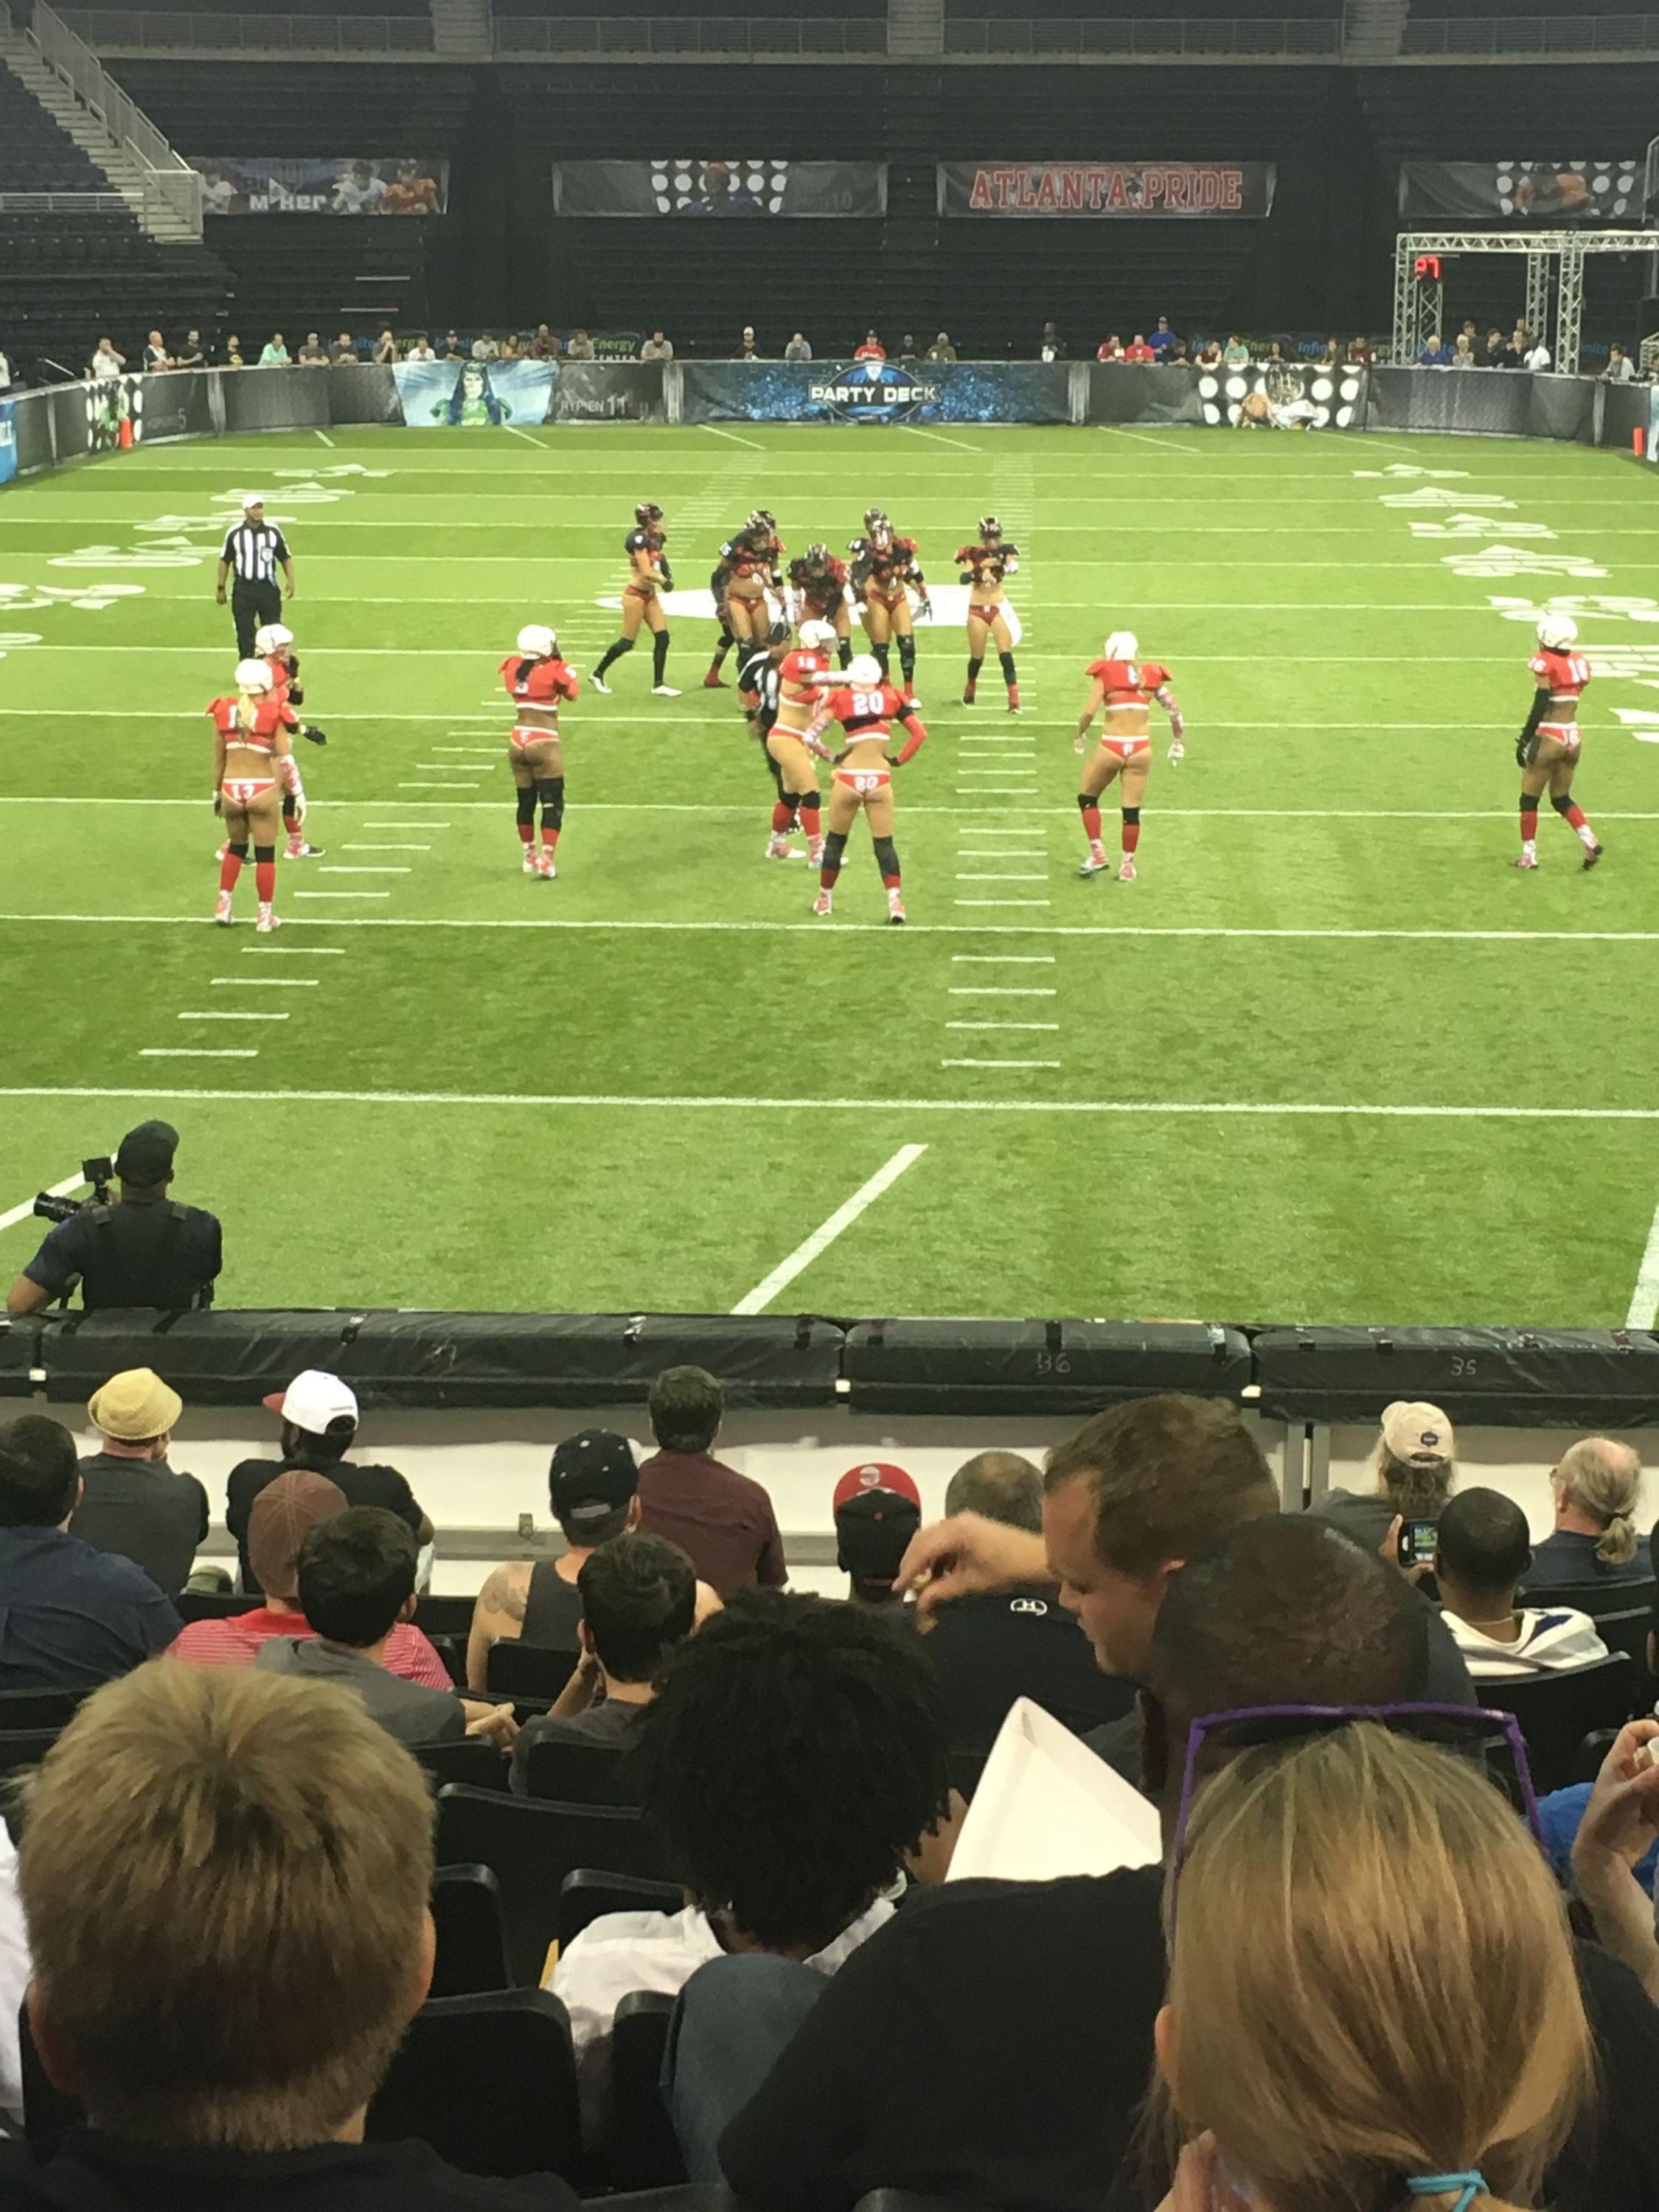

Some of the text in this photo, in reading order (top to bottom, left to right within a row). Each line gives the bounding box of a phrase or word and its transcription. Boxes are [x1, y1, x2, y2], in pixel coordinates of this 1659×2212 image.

[970, 170, 1243, 209] ATLANTA PRIDE
[811, 386, 937, 403] PARTY DECK
[852, 691, 884, 716] 20
[854, 775, 880, 792] 20
[1450, 1355, 1477, 1377] 35
